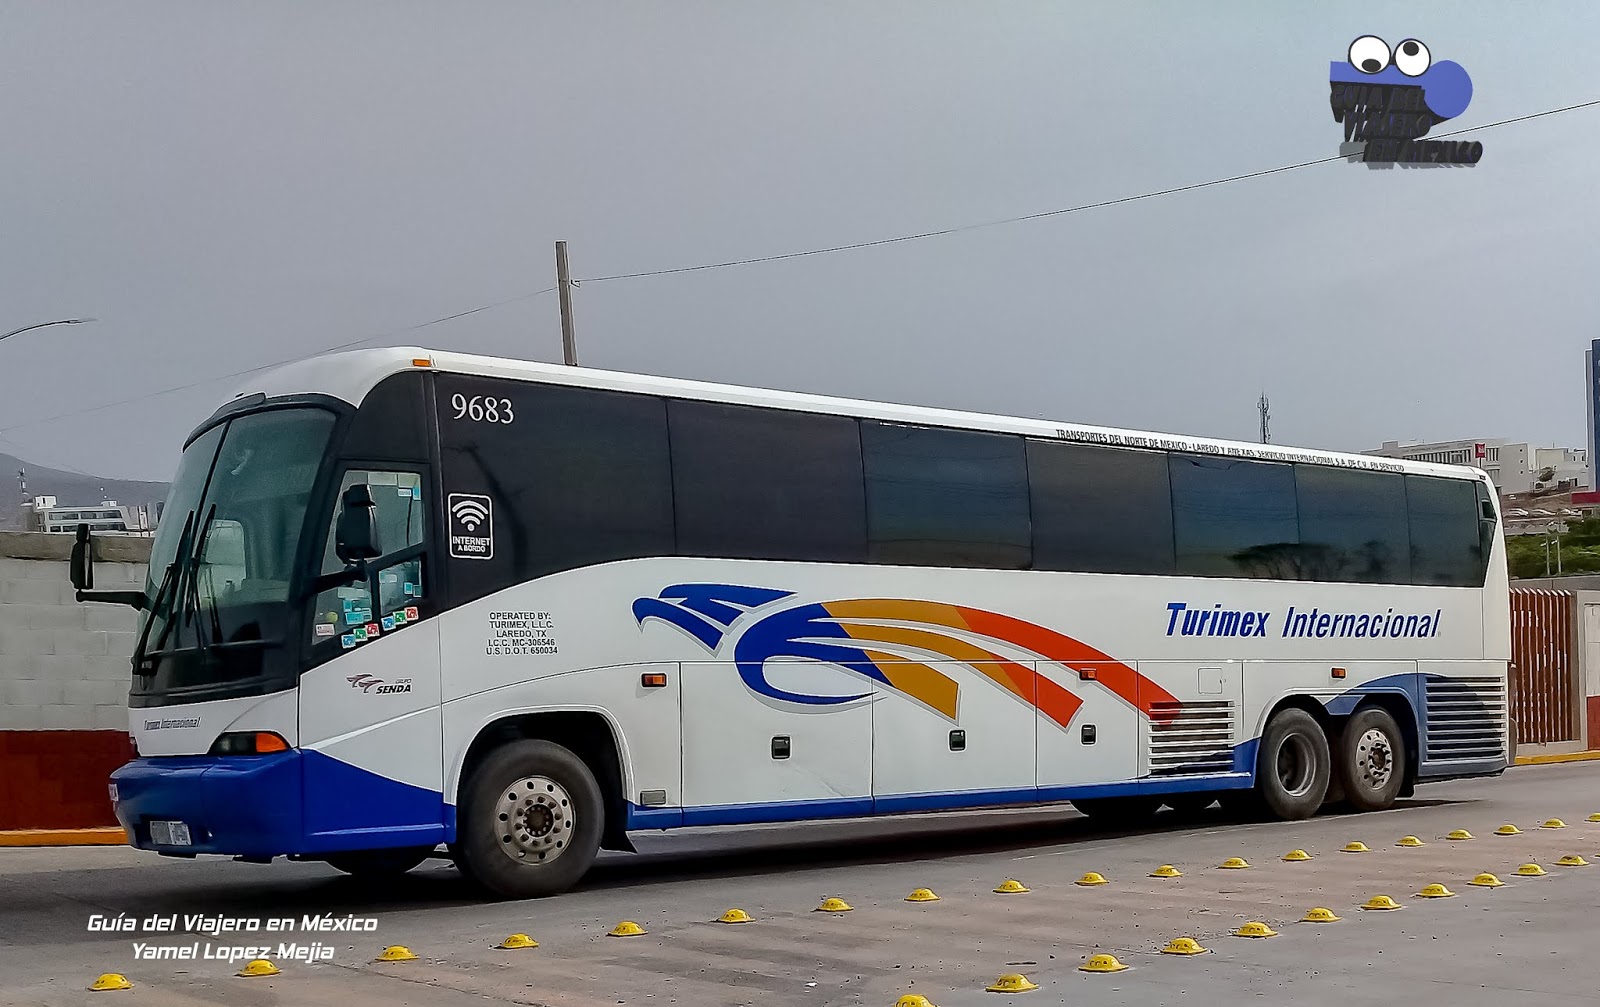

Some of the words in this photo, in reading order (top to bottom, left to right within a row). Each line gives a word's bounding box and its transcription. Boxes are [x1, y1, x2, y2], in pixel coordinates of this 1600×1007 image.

[451, 393, 514, 424] 9683
[1056, 429, 1107, 443] TRANSPORTES
[1109, 434, 1122, 445] DEL
[1124, 436, 1147, 447] NORTE
[1149, 438, 1158, 448] DE
[1160, 439, 1187, 451] MEXICO
[1193, 443, 1219, 454] LAREDO
[1221, 446, 1225, 454] Y
[1258, 450, 1285, 460] SERVICIO
[1348, 459, 1356, 468] DE
[1380, 463, 1404, 472] SERVICIO
[452, 536, 490, 546] INTERNET
[489, 612, 535, 620] OPERATED
[537, 612, 551, 620] BY:
[1166, 602, 1270, 637] Turimex
[1282, 607, 1441, 638] Internacional
[489, 620, 530, 629] TURIMEX,
[496, 630, 534, 638] LAREDO,
[536, 630, 547, 638] TX
[512, 638, 555, 647] MC-306546
[486, 647, 503, 655] U.S.
[505, 646, 529, 655] D.O.T.
[530, 646, 558, 654] 650034
[376, 684, 411, 694] SENDA
